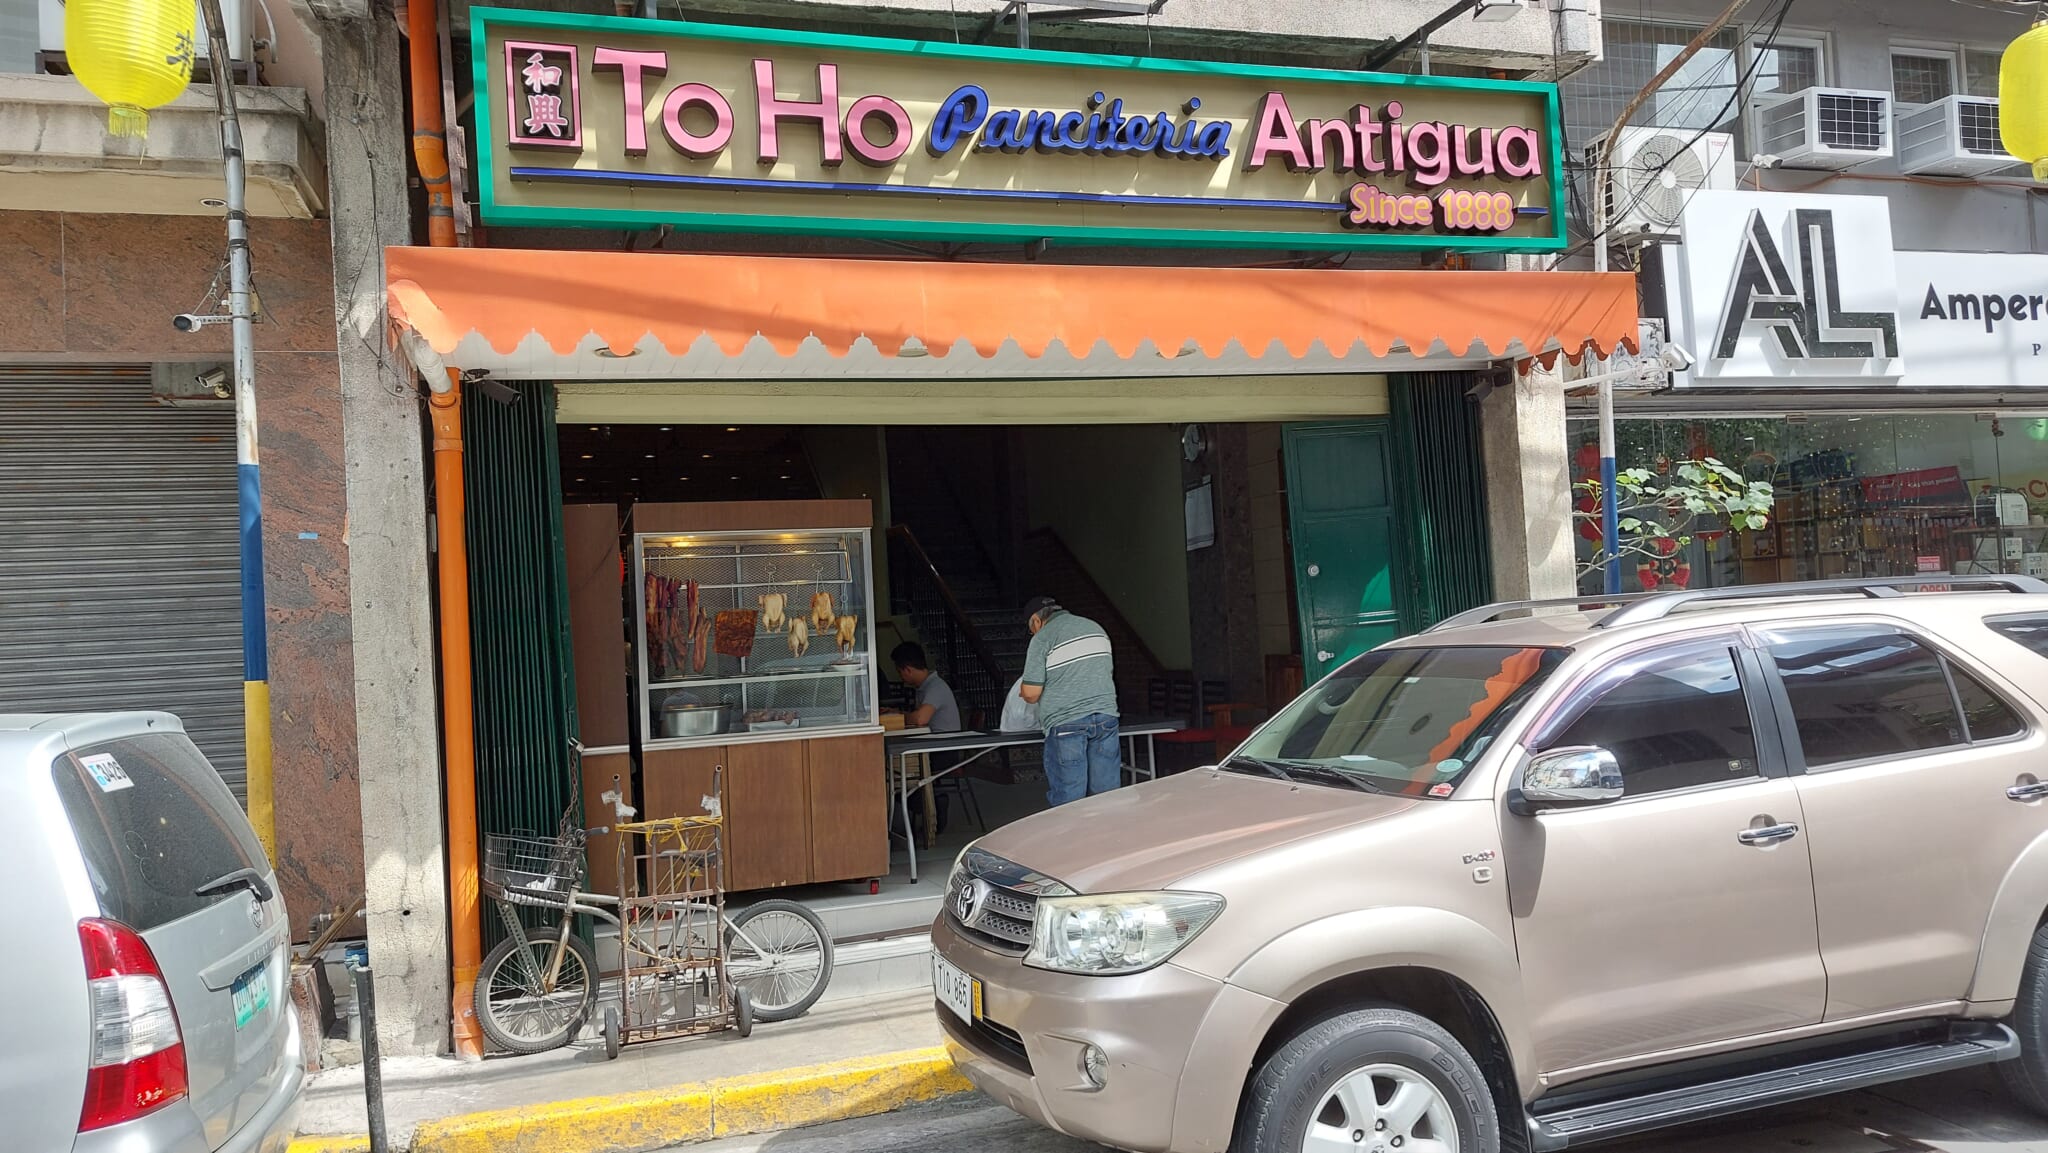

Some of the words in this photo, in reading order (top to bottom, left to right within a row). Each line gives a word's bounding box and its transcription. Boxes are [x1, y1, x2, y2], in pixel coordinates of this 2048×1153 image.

[522, 52, 568, 137] 和興
[592, 46, 734, 157] To
[751, 58, 913, 167] Ho
[928, 84, 1232, 156] Panciteria
[1247, 91, 1541, 186] Antigua
[1350, 183, 1433, 226] Since
[1438, 188, 1515, 231] 1888
[1920, 281, 2048, 333] Amper
